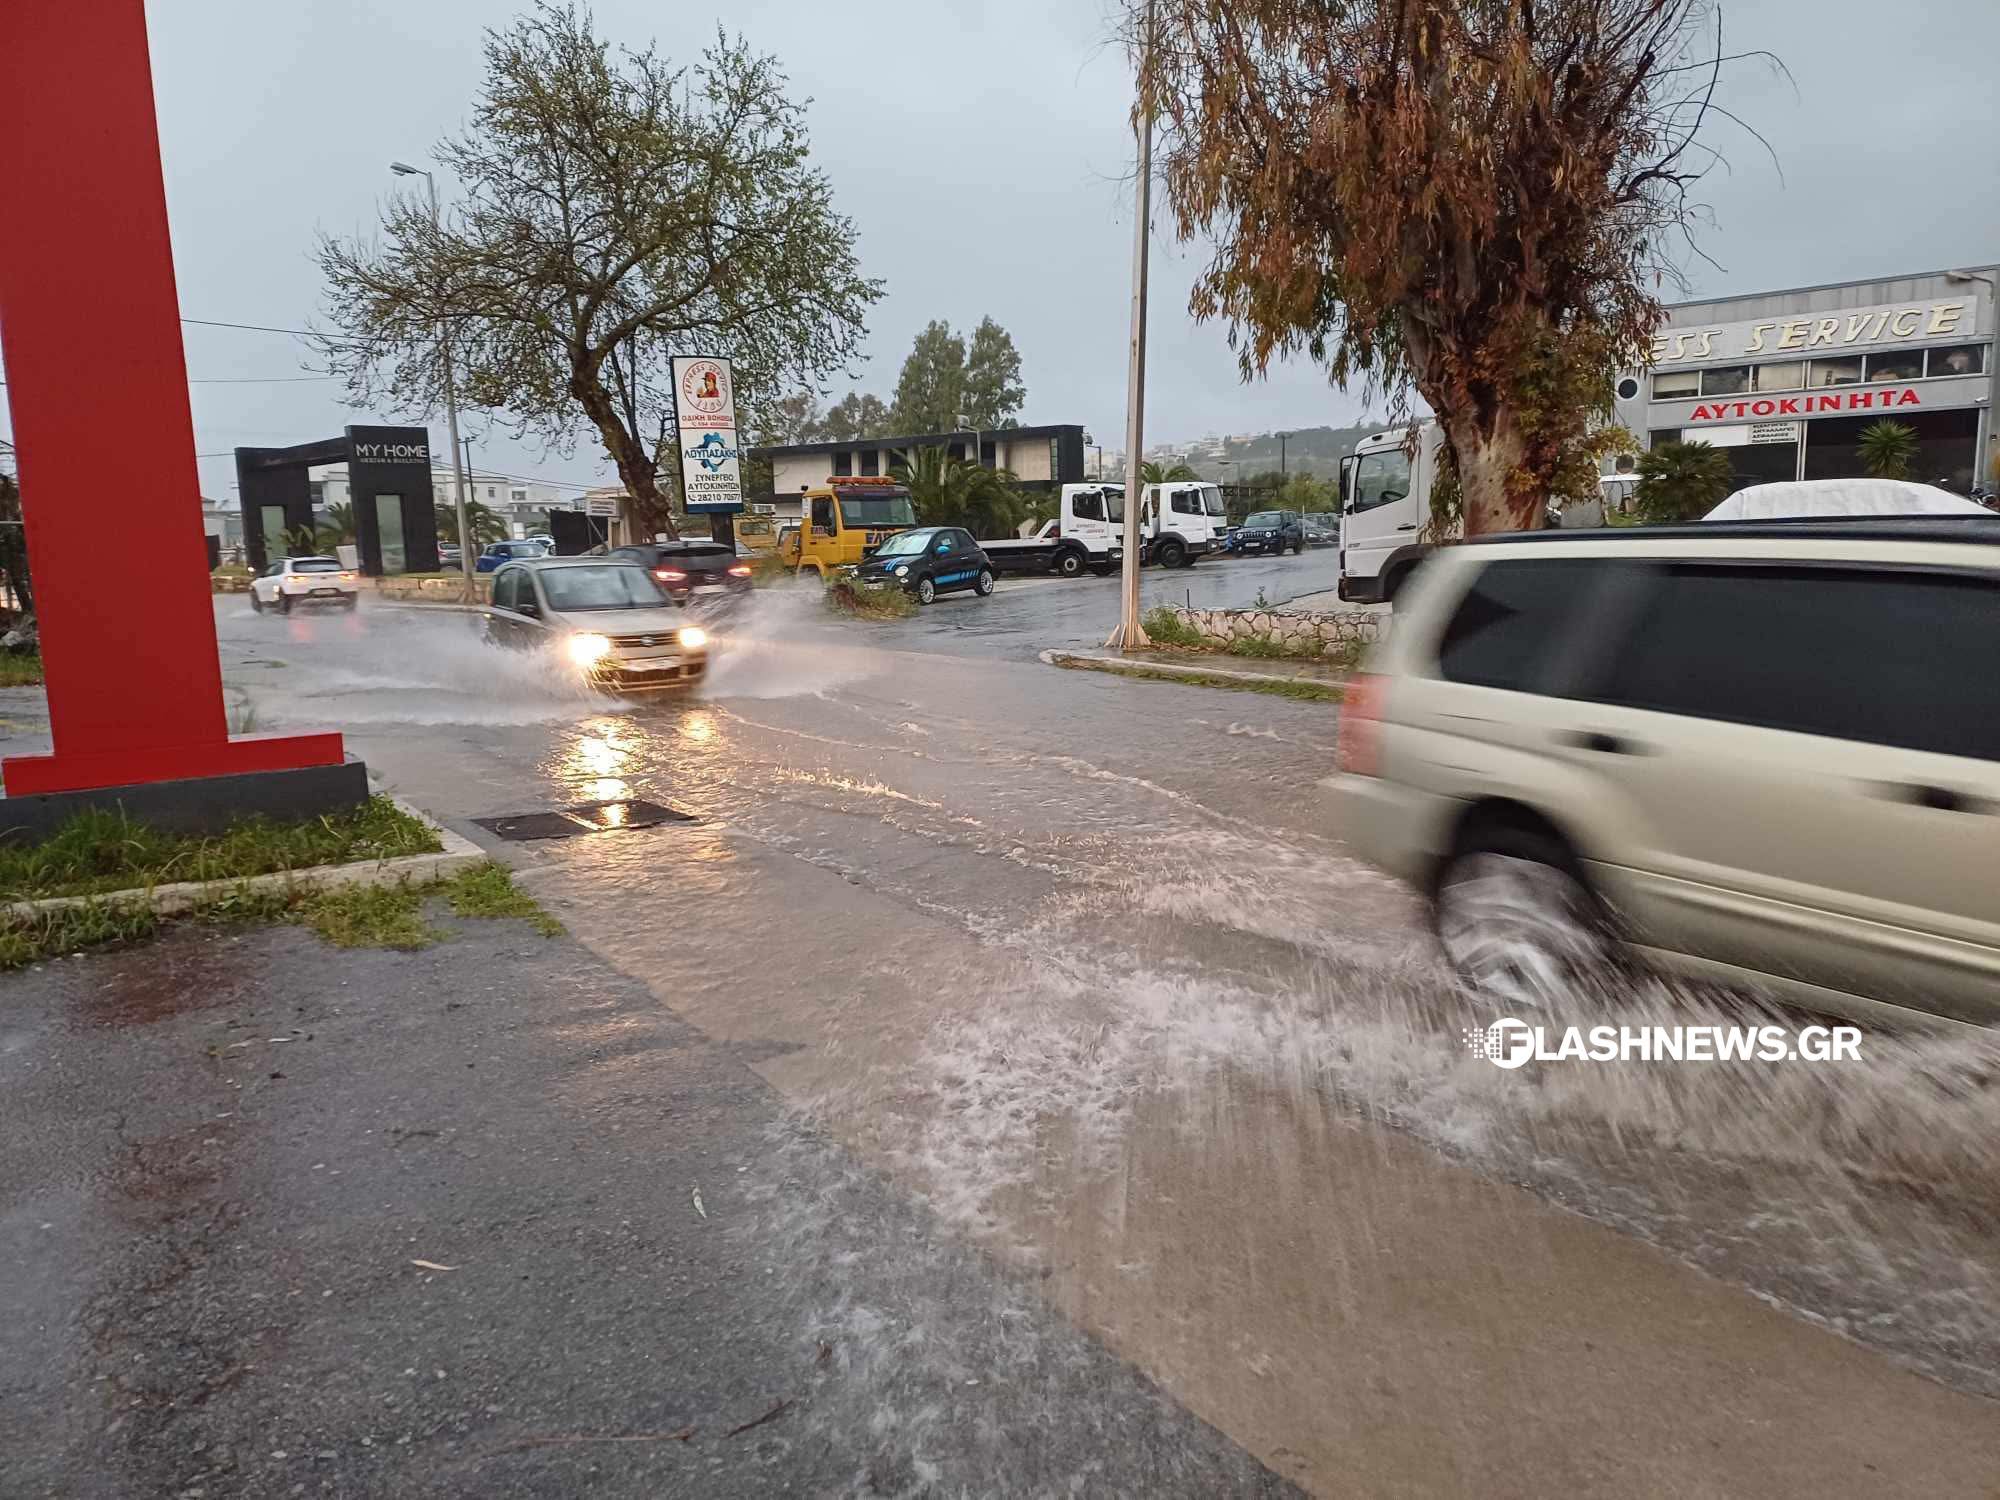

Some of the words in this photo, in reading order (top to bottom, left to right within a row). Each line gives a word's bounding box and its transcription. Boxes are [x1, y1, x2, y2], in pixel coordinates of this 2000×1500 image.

[1743, 303, 1965, 353] SERVICE
[1689, 387, 1921, 422] ΑΥΤΟΚΙΝΗΤΑ
[355, 443, 381, 457] MY
[383, 444, 428, 458] HOME
[697, 493, 722, 502] 28210
